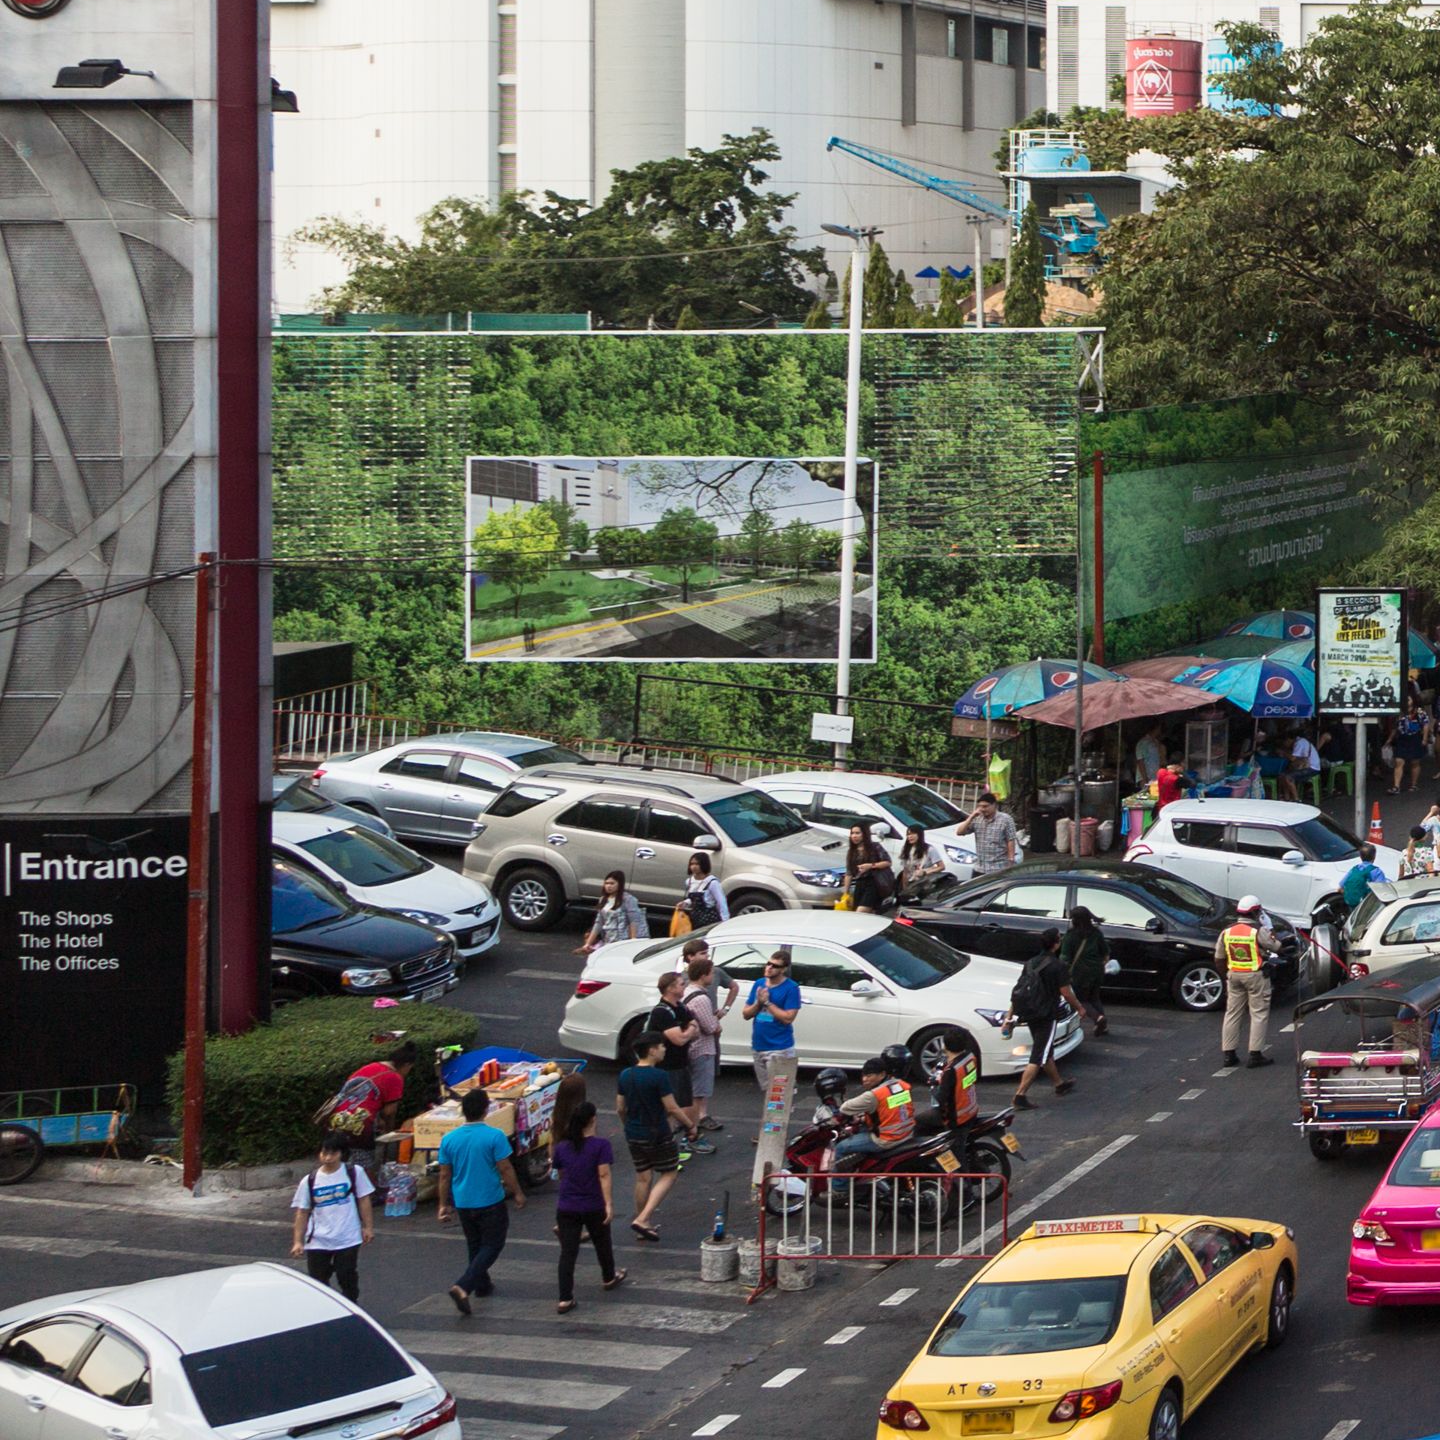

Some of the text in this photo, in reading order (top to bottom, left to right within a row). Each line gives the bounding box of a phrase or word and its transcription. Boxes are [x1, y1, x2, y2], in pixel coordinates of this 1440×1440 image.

[1344, 596, 1380, 605] SECONDS
[1351, 630, 1371, 640] FEELS
[1263, 704, 1298, 715] pepsi
[19, 852, 188, 880] Entrance
[19, 910, 114, 928] The Shops
[19, 933, 104, 948] The Hotel
[19, 955, 120, 971] The Offices
[1048, 1220, 1124, 1234] TAXI-METER
[1022, 1378, 1044, 1391] 33
